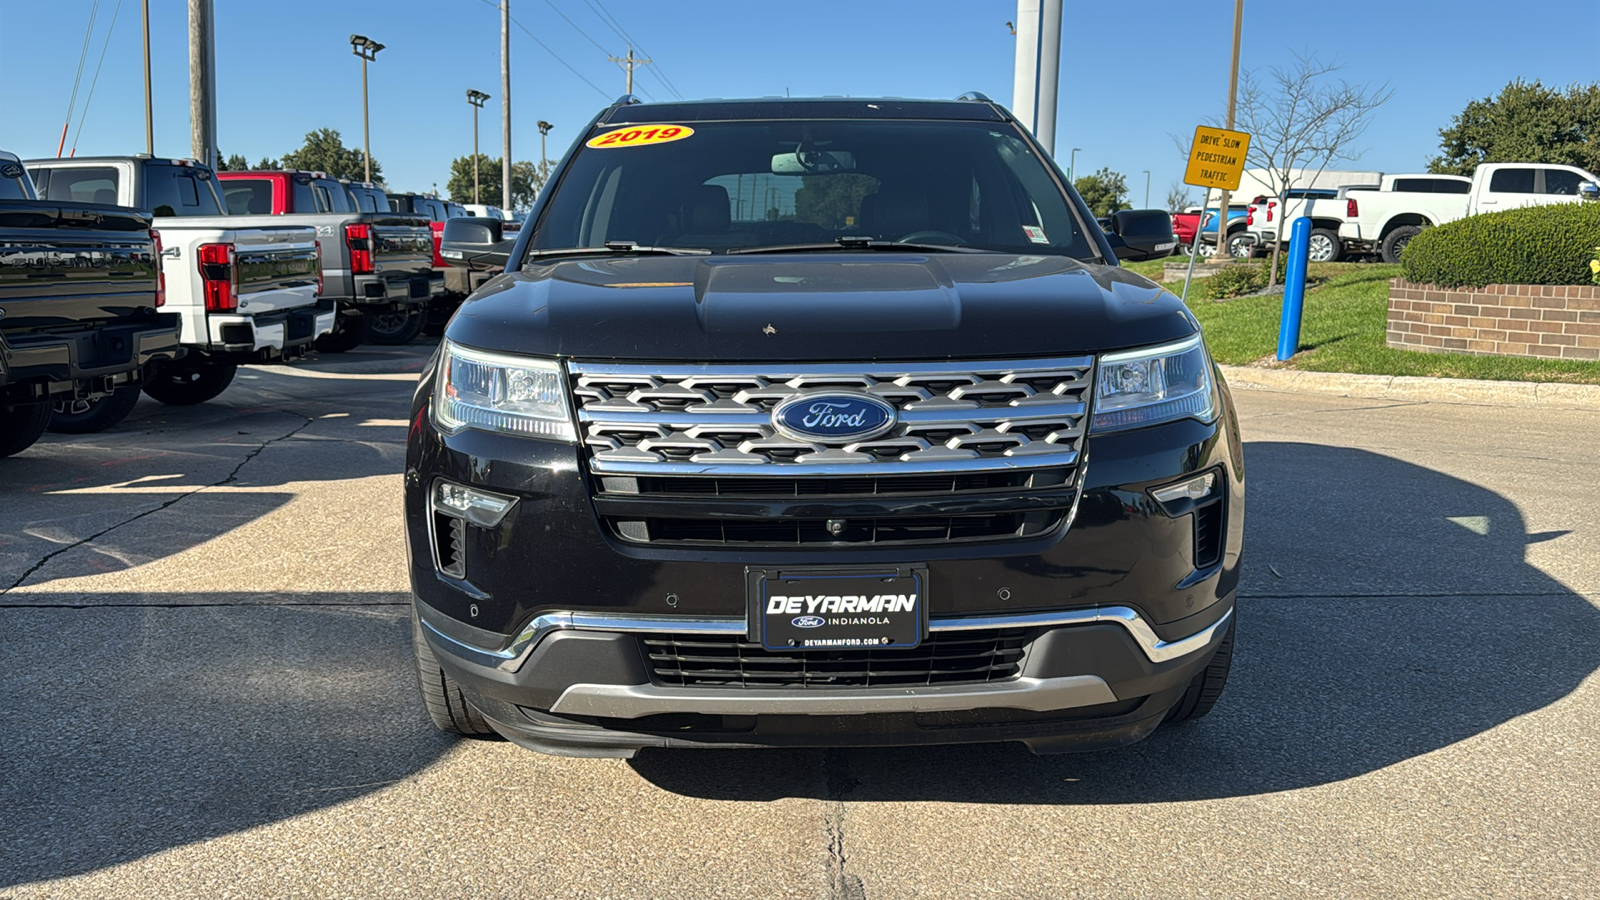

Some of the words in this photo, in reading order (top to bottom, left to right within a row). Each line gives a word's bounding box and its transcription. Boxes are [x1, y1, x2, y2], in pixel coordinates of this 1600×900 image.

[596, 128, 682, 146] 2019
[1200, 135, 1220, 146] DRIVE
[1223, 138, 1241, 149] SLOW
[1196, 151, 1237, 166] PEDESTRIAN
[1200, 169, 1228, 182] TRAFFIC
[802, 402, 867, 428] Ford
[766, 594, 917, 615] DEYARMAN
[797, 616, 818, 627] Ford
[828, 617, 890, 625] INDIANOLA
[804, 638, 879, 647] DEYARMANFORD.COM
